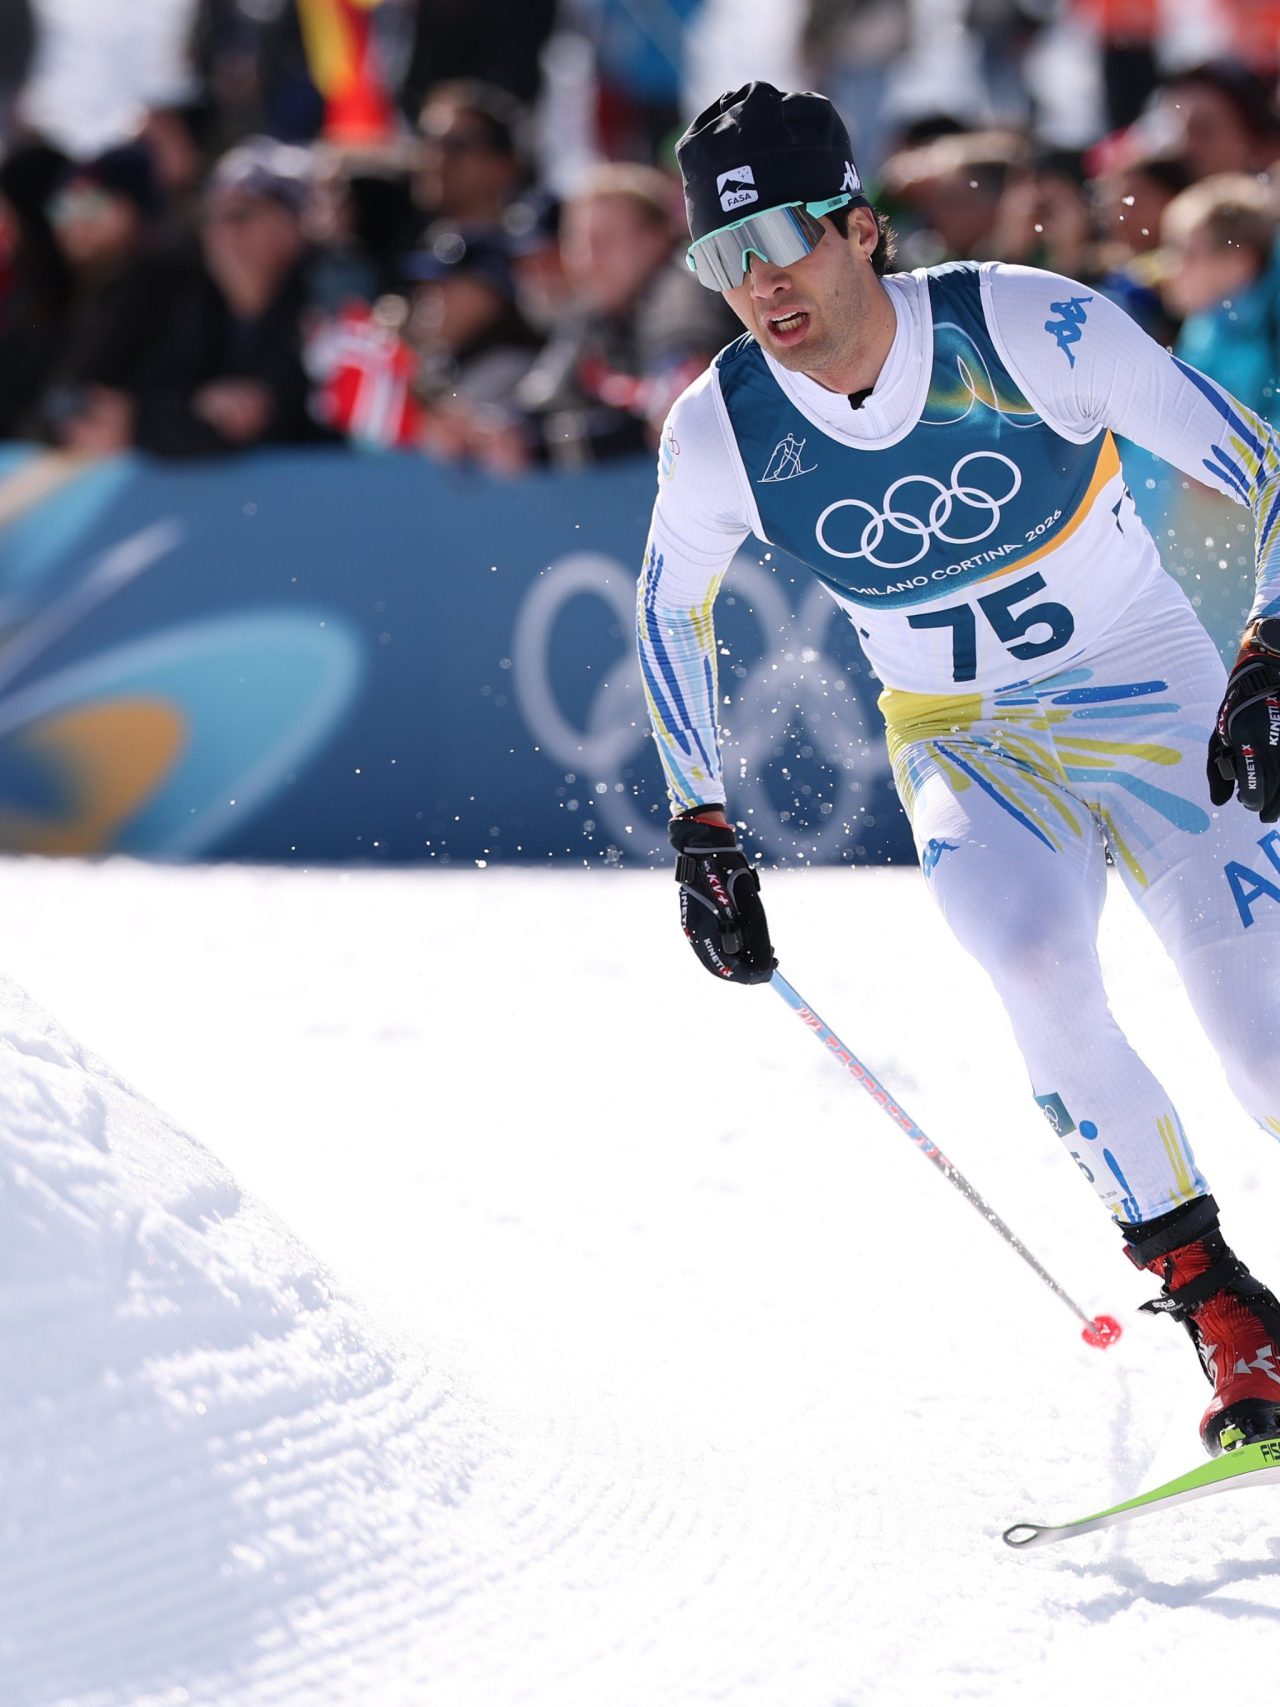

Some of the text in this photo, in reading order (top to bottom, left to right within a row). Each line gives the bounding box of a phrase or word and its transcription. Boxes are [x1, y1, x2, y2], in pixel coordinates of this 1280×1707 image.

[727, 192, 752, 208] FASA
[849, 508, 1062, 596] MILANO CORTINA 2026
[906, 570, 1075, 682] 75
[1241, 743, 1256, 790] KINETIX
[703, 937, 734, 978] KINETIX
